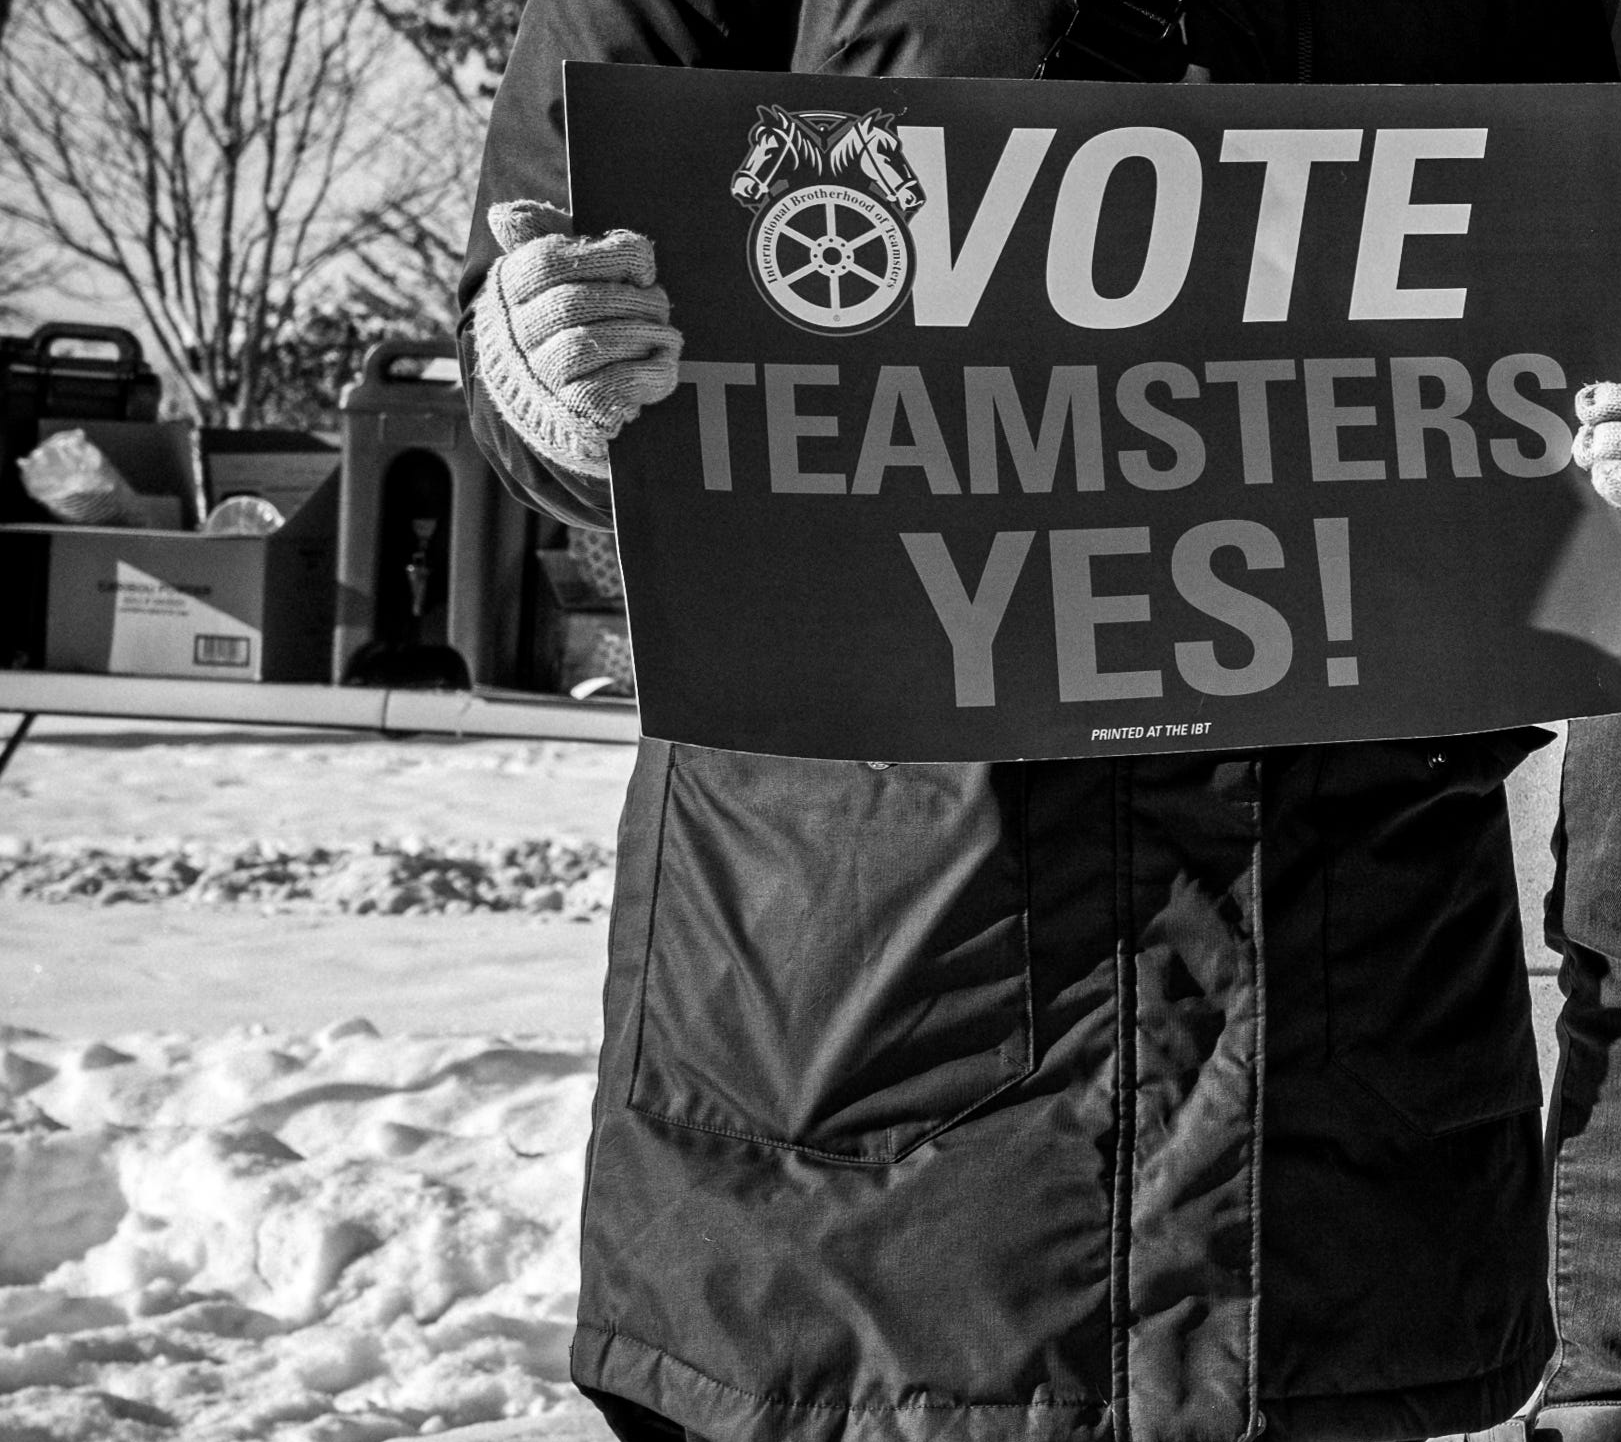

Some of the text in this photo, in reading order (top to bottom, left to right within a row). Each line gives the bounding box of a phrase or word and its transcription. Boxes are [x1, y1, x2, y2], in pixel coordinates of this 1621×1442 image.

[762, 188, 903, 291] International Brotherhood of Teamsters
[900, 124, 1490, 330] VOTE
[677, 351, 1578, 497] TEAMSTERS
[899, 516, 1361, 709] YES!
[1091, 722, 1212, 741] PRINTED AT THE IBT
